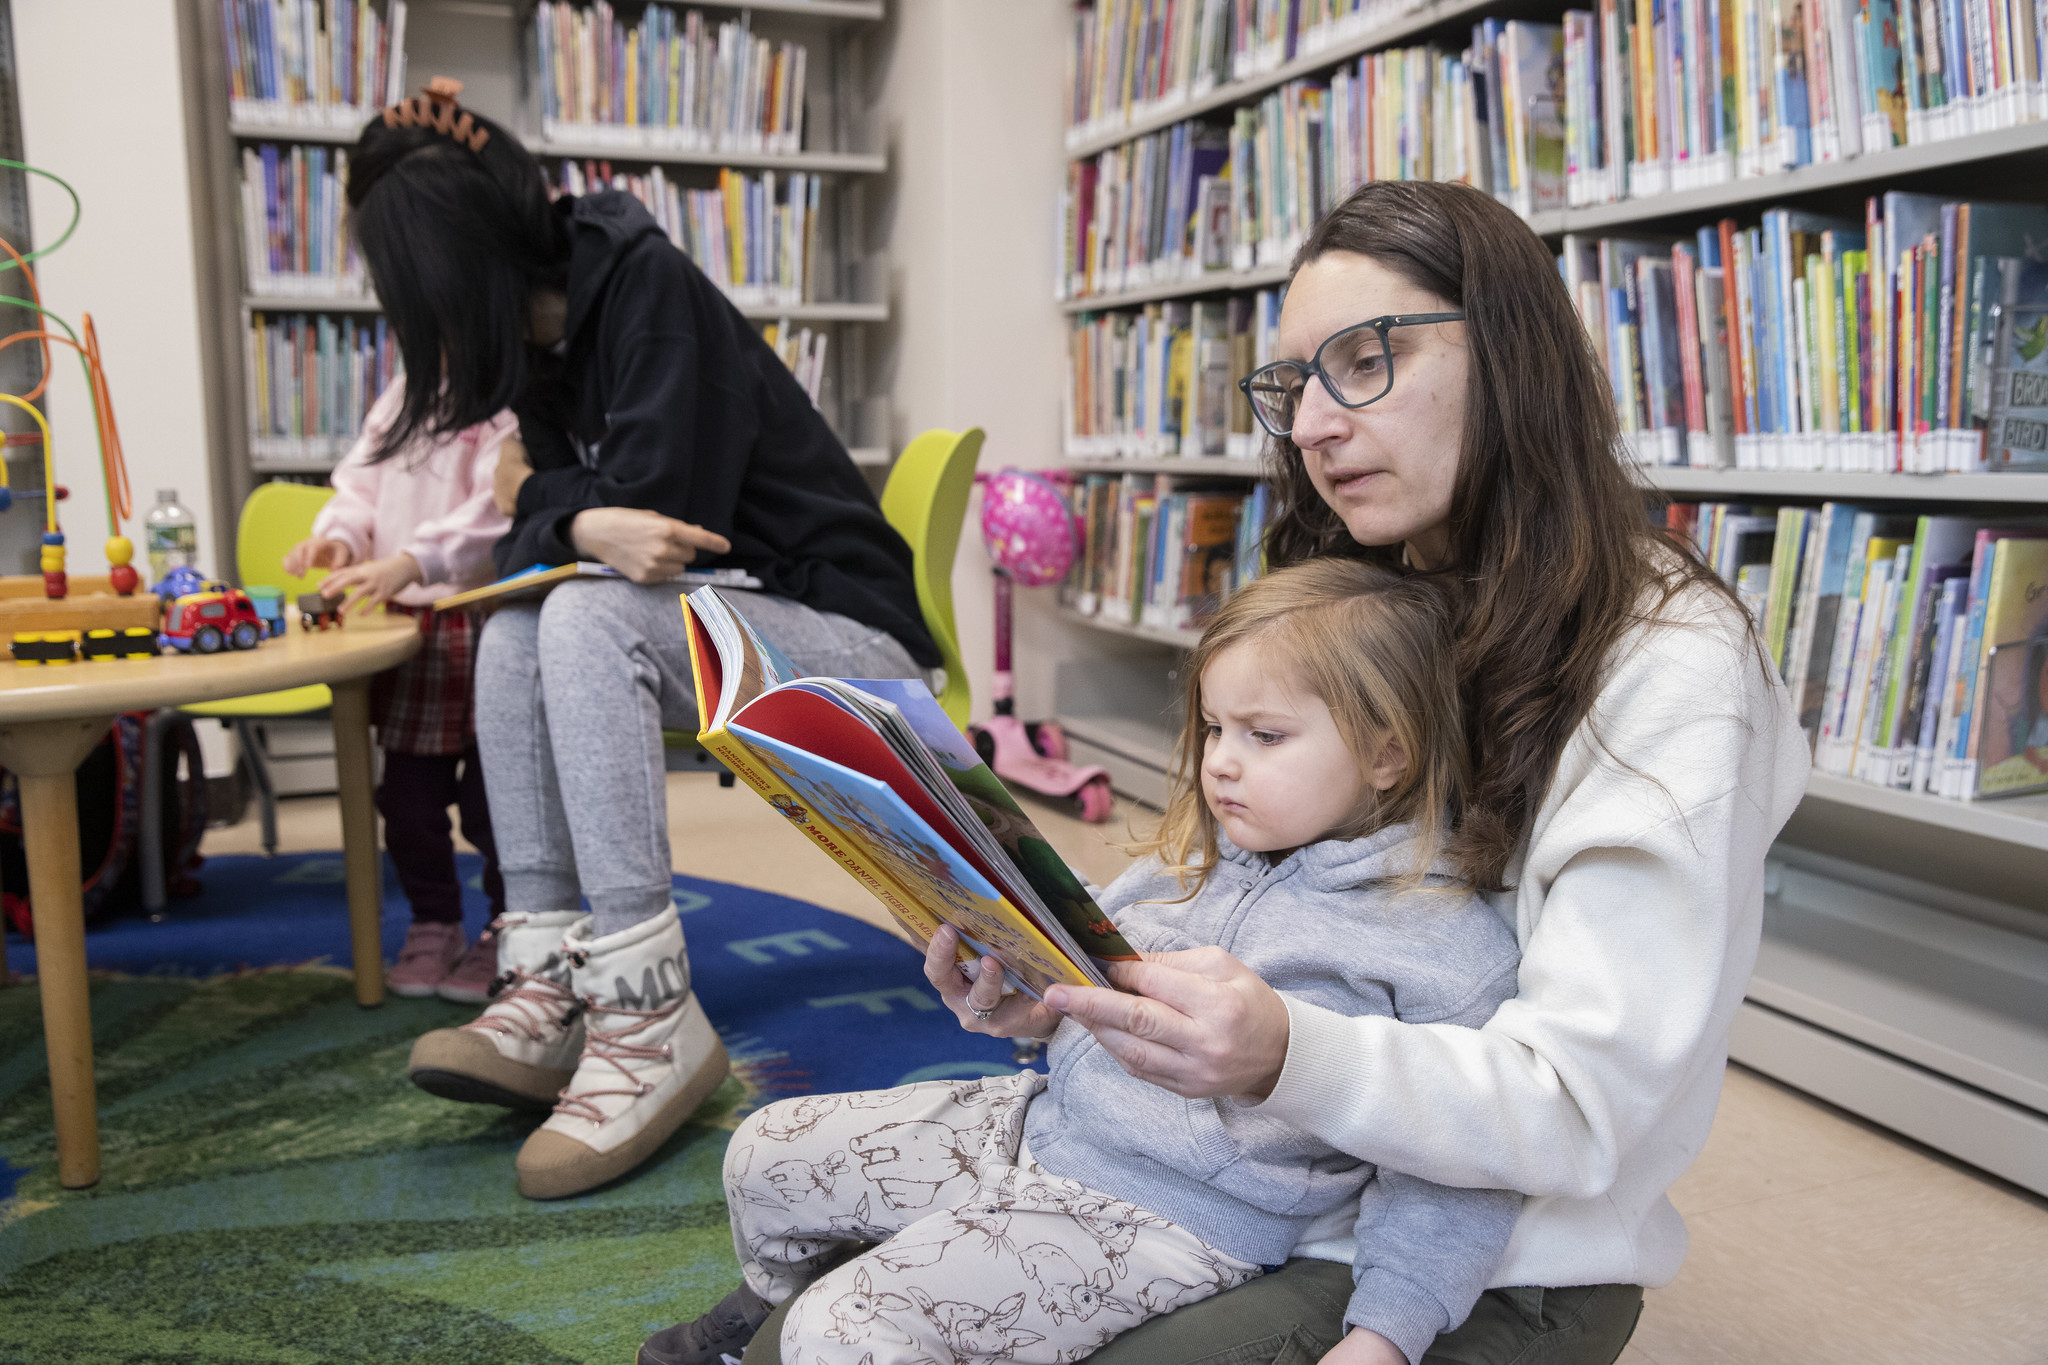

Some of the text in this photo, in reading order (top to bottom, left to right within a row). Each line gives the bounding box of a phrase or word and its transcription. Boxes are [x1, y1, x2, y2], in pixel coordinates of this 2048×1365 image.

[715, 746, 767, 791] NEIGHBORHOOD
[721, 745, 771, 789] DANIEL TIGER'S
[805, 824, 847, 859] MORE
[844, 858, 881, 891] DANIEL
[880, 890, 910, 916] TIGER
[907, 914, 934, 938] 5-Min
